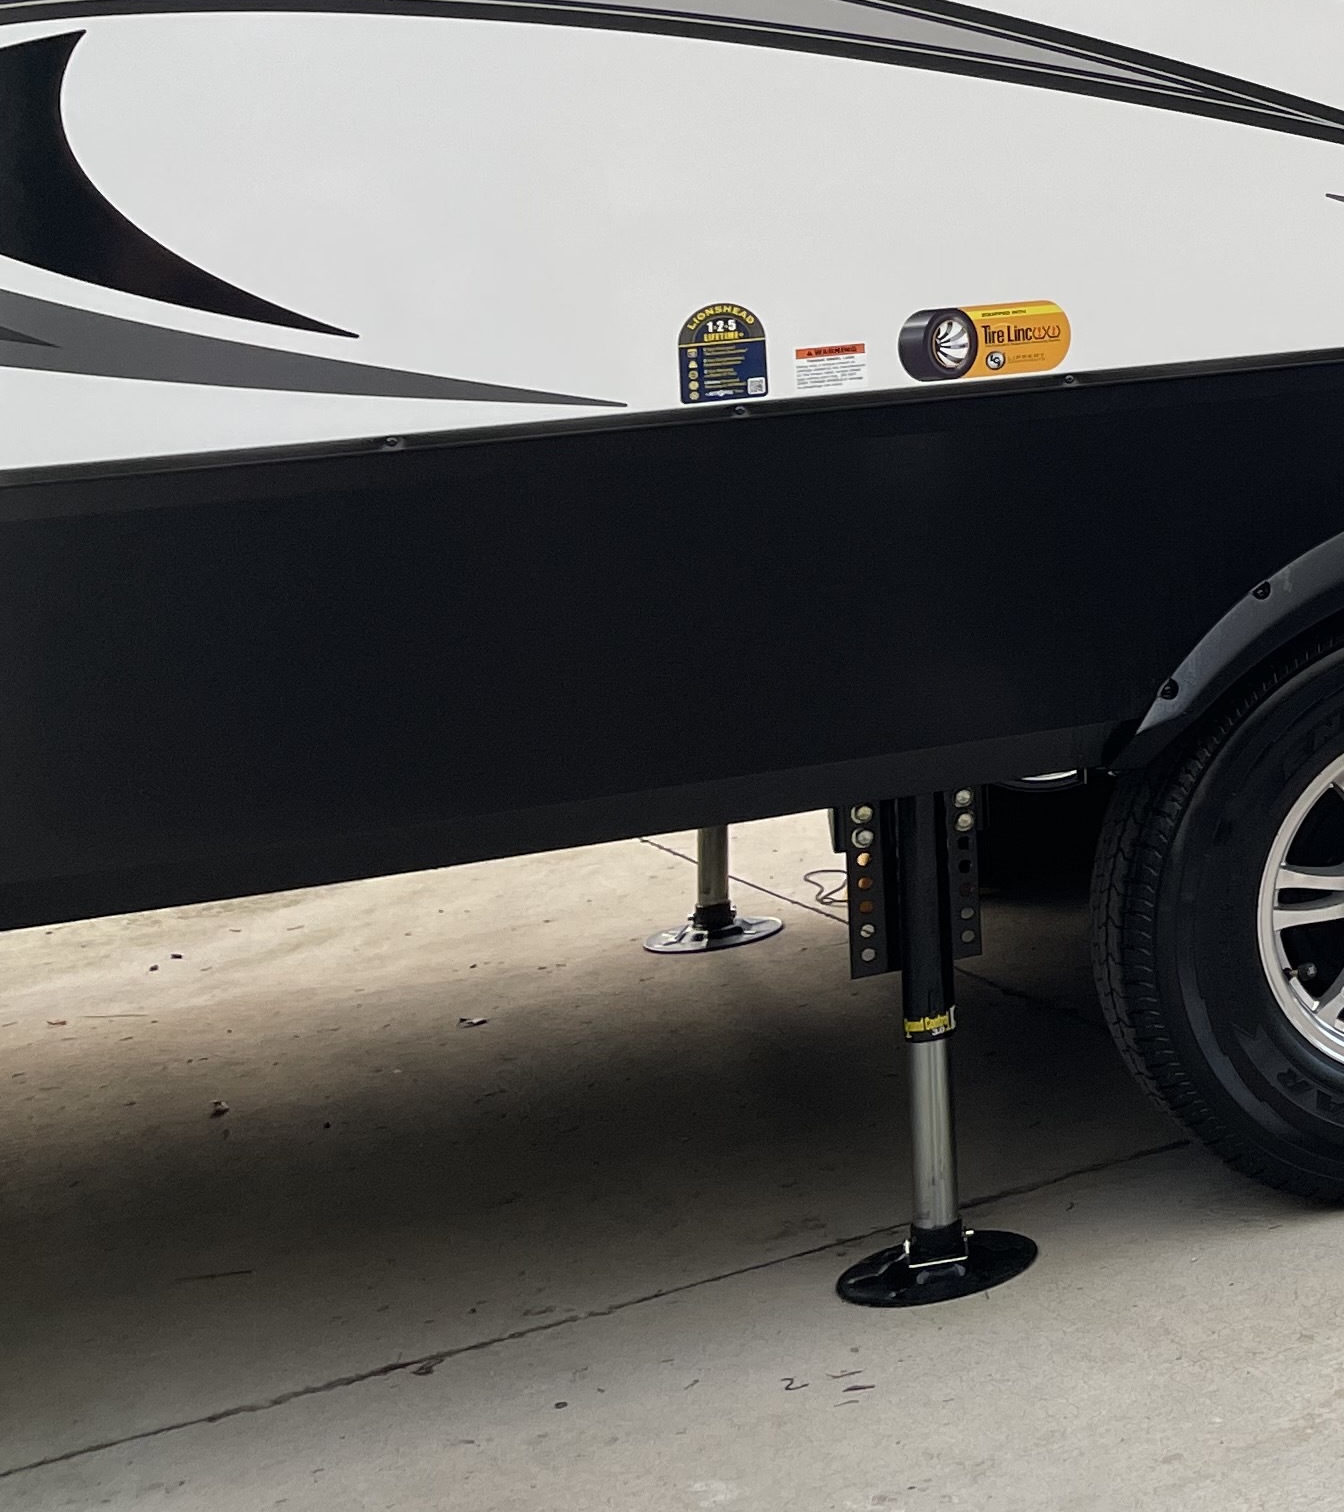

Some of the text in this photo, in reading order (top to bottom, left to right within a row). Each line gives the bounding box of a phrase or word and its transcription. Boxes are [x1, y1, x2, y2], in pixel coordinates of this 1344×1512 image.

[687, 305, 755, 330] LIONSHEAD
[981, 325, 1004, 345] Tire
[1006, 324, 1033, 343] Linc
